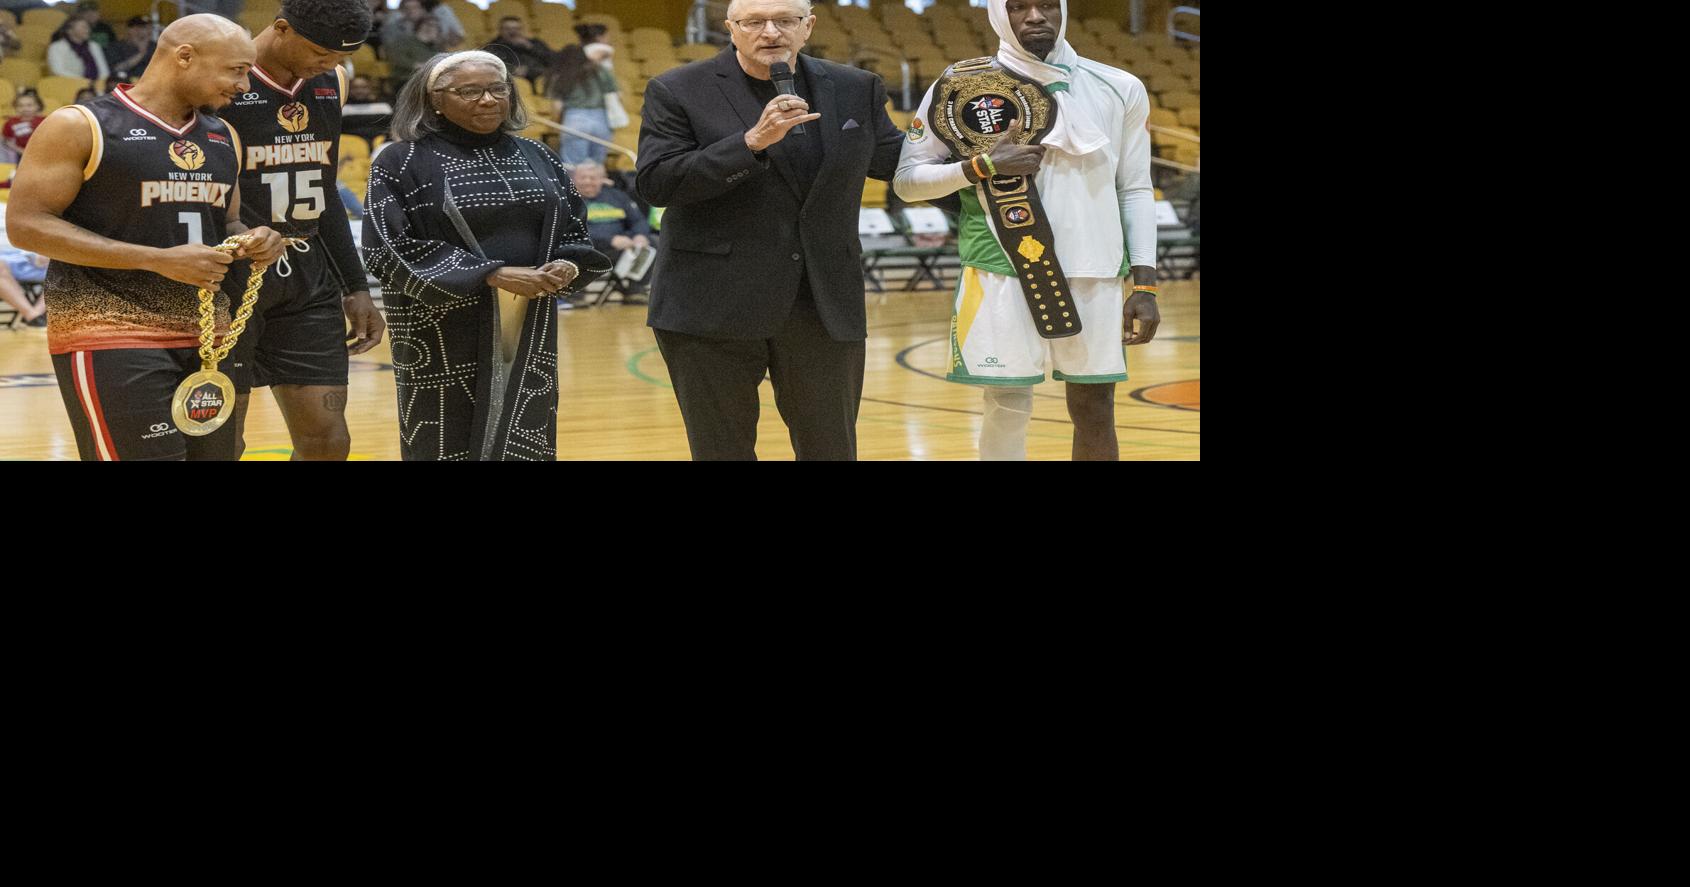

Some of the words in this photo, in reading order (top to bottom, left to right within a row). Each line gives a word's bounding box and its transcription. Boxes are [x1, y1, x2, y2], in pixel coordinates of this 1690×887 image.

[976, 109, 993, 134] STAR
[988, 108, 1004, 125] ALL
[274, 134, 293, 144] NEW
[294, 133, 315, 142] YORK
[168, 172, 187, 181] NEW
[189, 172, 213, 181] YORK
[141, 181, 232, 209] PHOENIX
[261, 169, 326, 223] 15
[178, 211, 204, 245] 1
[202, 391, 217, 400] ALL
[190, 408, 217, 419] MVP
[141, 428, 178, 439] WOOTER
